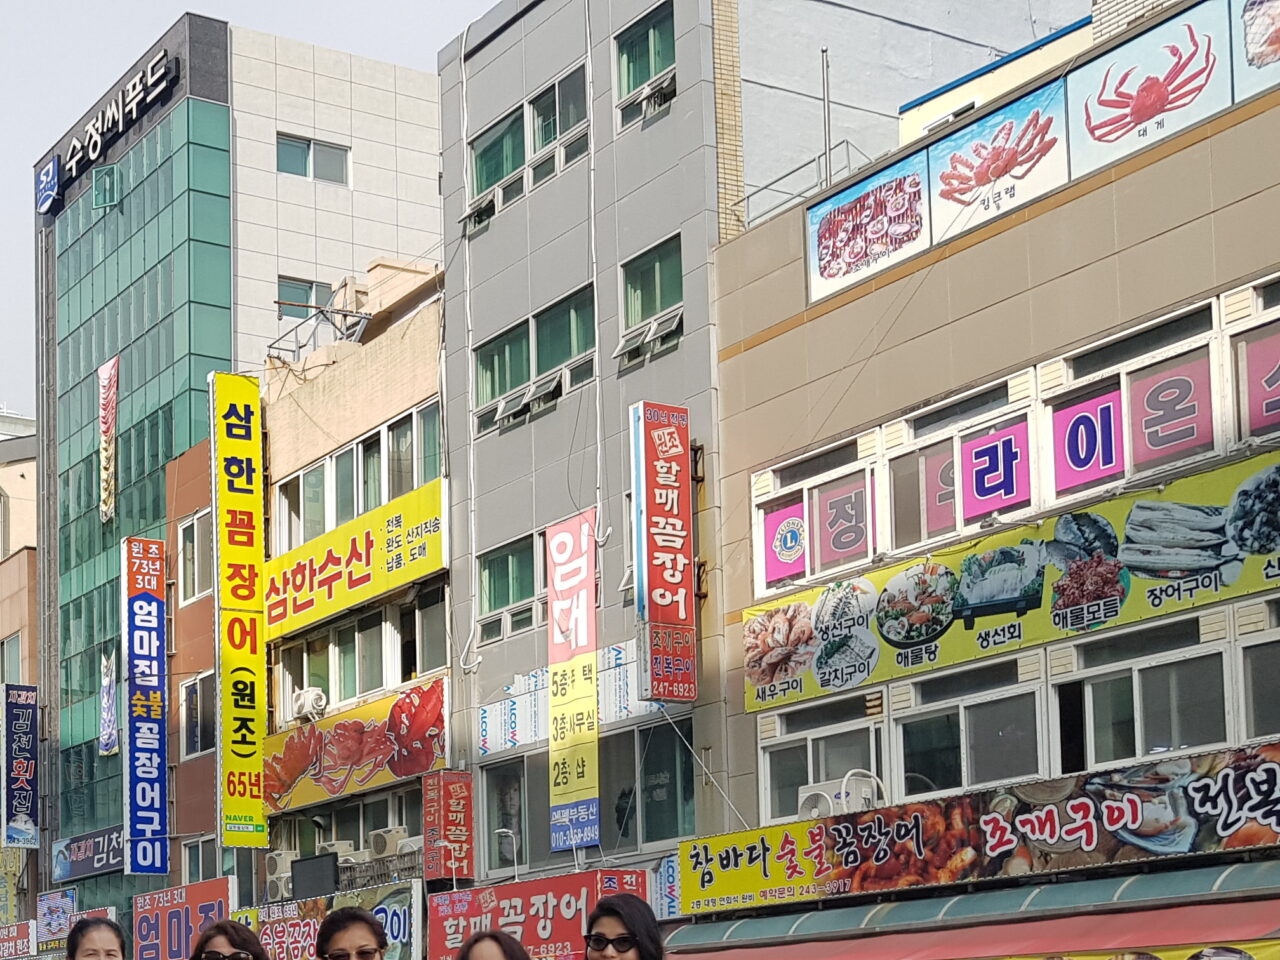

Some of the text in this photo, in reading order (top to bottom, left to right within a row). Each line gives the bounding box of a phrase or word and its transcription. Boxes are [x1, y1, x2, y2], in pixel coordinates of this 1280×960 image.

[65, 48, 169, 178] 수정씨푸드
[645, 408, 668, 424] 30년
[385, 513, 403, 529] 전복
[385, 516, 441, 553] 완도 산지직송
[131, 542, 161, 558] 원조
[408, 541, 428, 563] 도매
[131, 558, 161, 576] 73년
[264, 529, 375, 626] 삼한수산
[134, 575, 158, 590] 3대
[548, 520, 591, 651] 임대
[1146, 570, 1220, 609] 장어구이
[817, 612, 870, 642] 생선구이
[1051, 596, 1121, 630] 해물모듬
[132, 600, 159, 687] 엄마집
[651, 630, 694, 654] 조개구이
[975, 620, 1023, 649] 생선회
[651, 654, 694, 682] 전복구이
[894, 641, 940, 669] 해물탕
[818, 658, 872, 690] 갈치구이
[651, 681, 695, 698] 247-6923
[754, 676, 804, 704] 새우구이
[131, 690, 164, 720] 숯불
[569, 709, 595, 735] 사무실
[226, 771, 262, 799] 65년
[225, 814, 255, 822] NAVER
[980, 792, 1144, 858] 조개구이
[689, 834, 772, 891] 참바다
[136, 887, 187, 912] 원조 73년 3대
[759, 887, 796, 901] 예약문의
[799, 878, 852, 896] 243-3917
[283, 903, 299, 917] 65년
[526, 941, 571, 957] 7-6923
